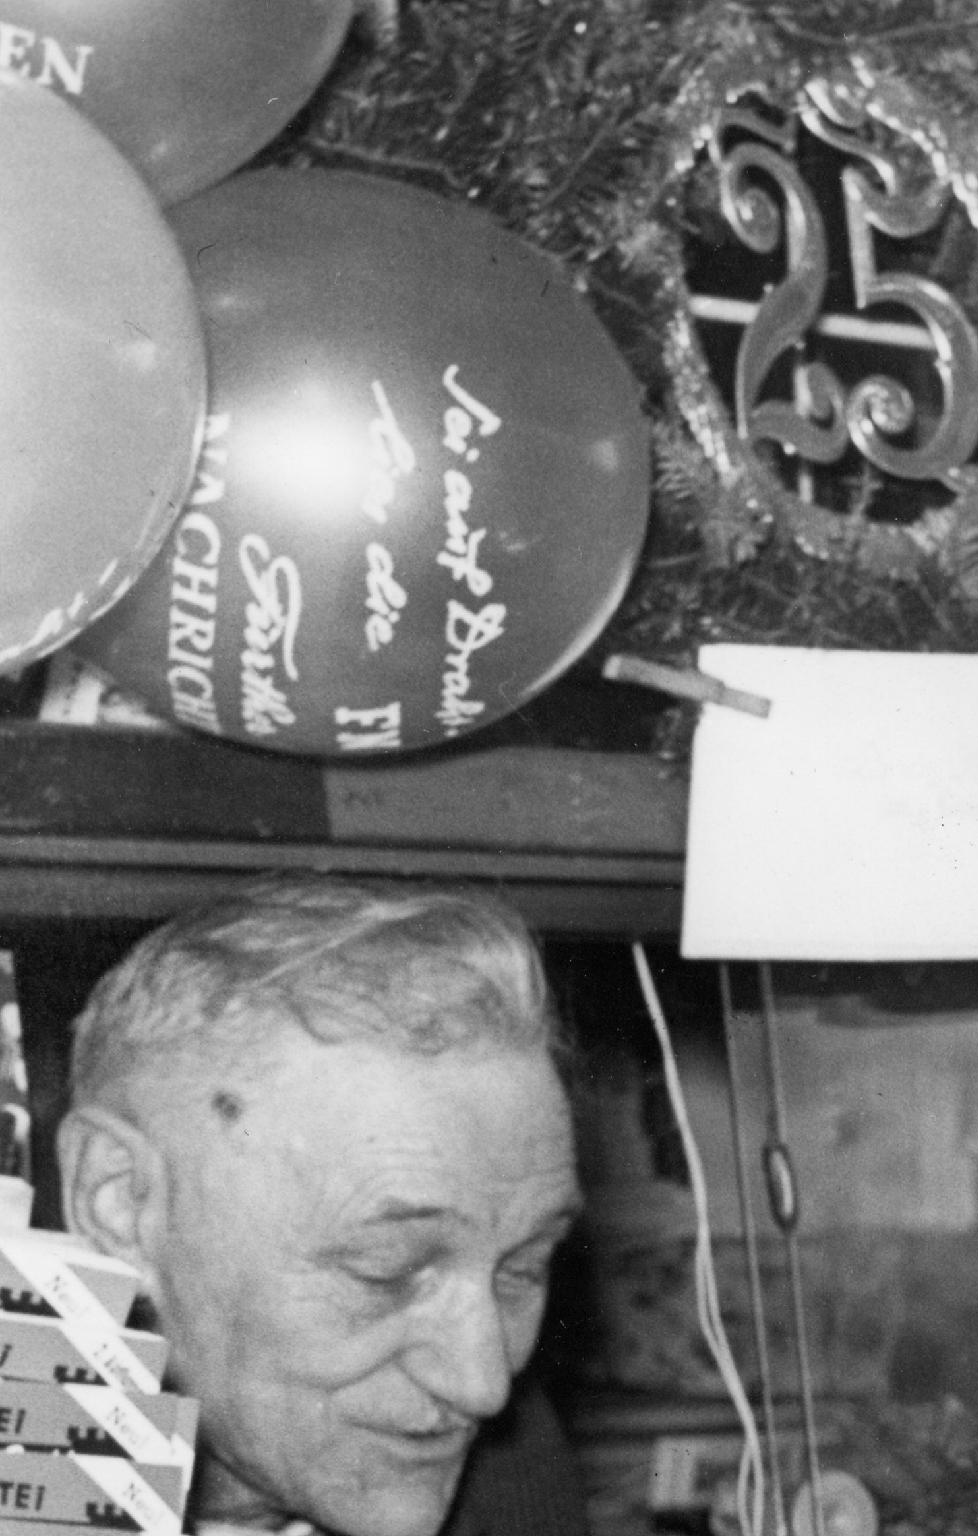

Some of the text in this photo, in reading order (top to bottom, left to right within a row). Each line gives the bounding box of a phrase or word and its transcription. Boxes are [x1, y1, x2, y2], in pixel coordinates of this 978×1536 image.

[442, 363, 502, 463] Sei
[436, 469, 493, 597] auf
[364, 541, 408, 652] die
